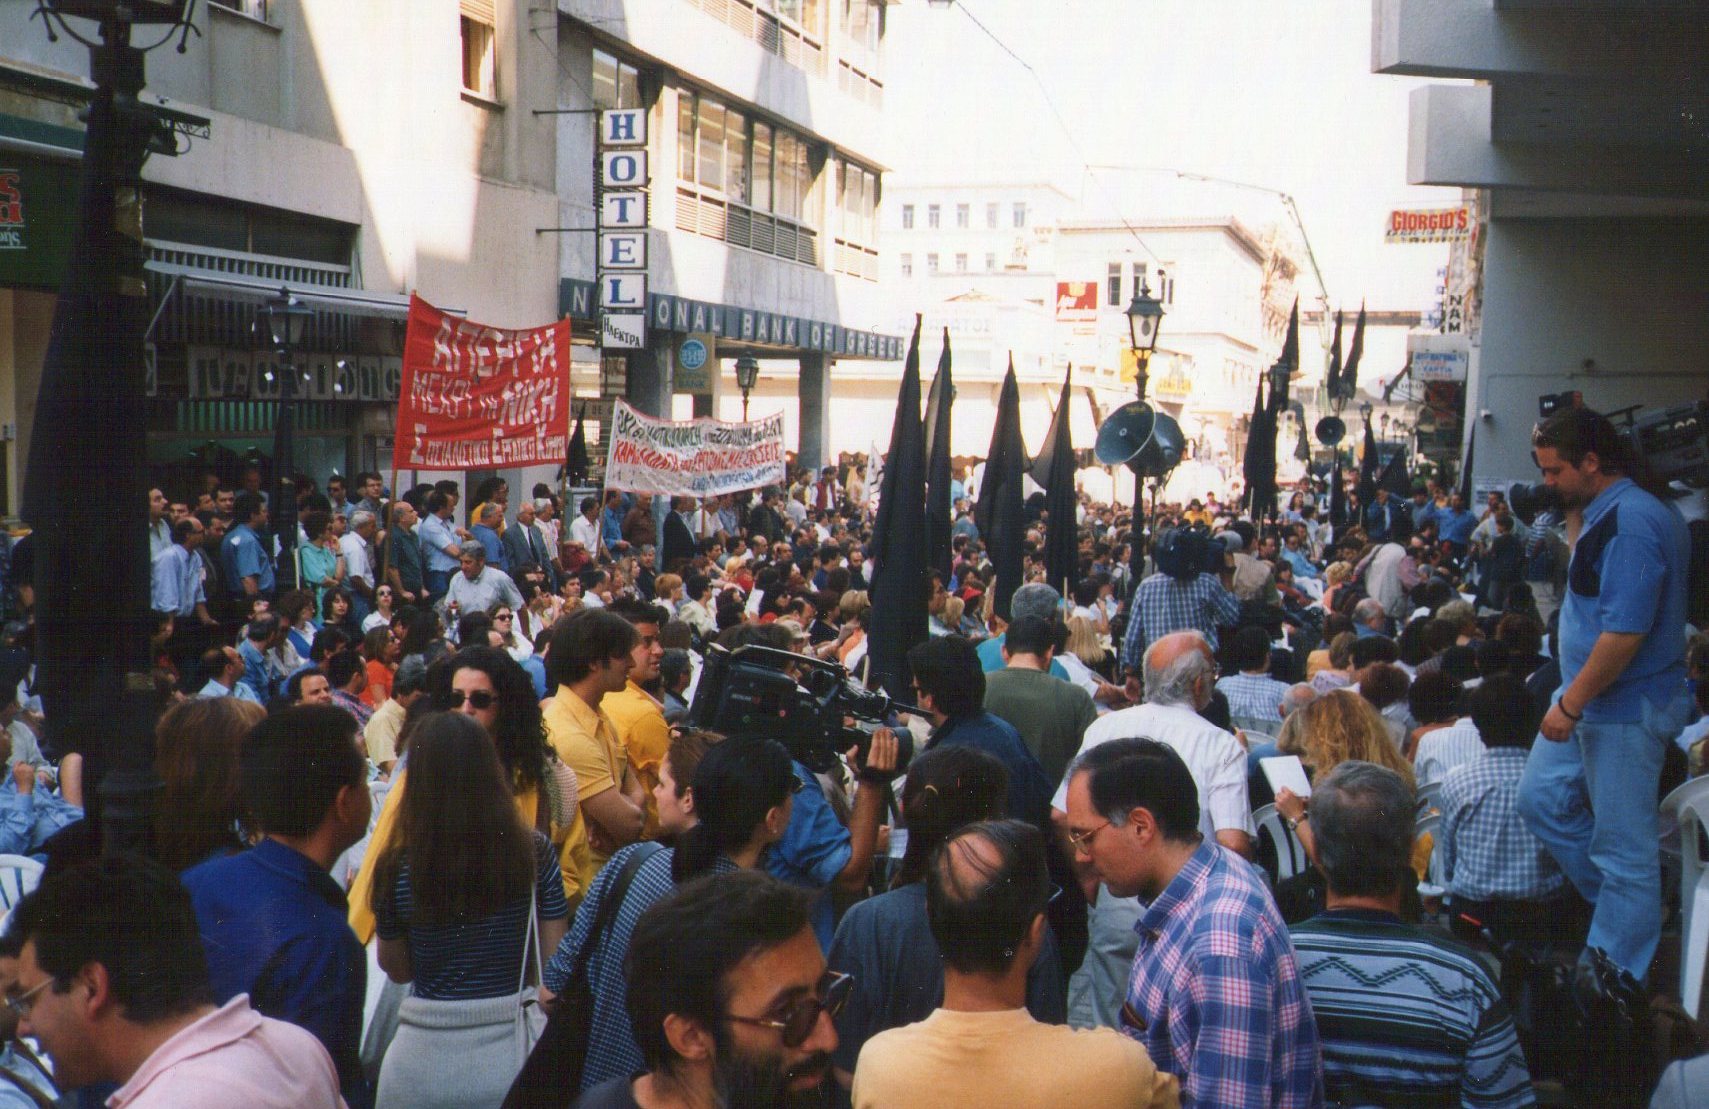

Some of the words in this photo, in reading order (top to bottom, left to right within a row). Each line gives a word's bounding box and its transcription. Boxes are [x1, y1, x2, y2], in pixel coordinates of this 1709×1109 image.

[609, 114, 637, 304] HOTEL
[433, 317, 556, 378] ΑΠΕΡΓΙΑ
[573, 285, 720, 332] NONAL
[742, 314, 795, 344] BANK
[811, 324, 833, 348] OF
[846, 331, 904, 360] GREECE
[603, 316, 640, 348] ΗΛΕΚΤΡΑ
[411, 370, 472, 419] ΜΕΧΡΙ
[499, 377, 559, 426] ΝΙΚΗ
